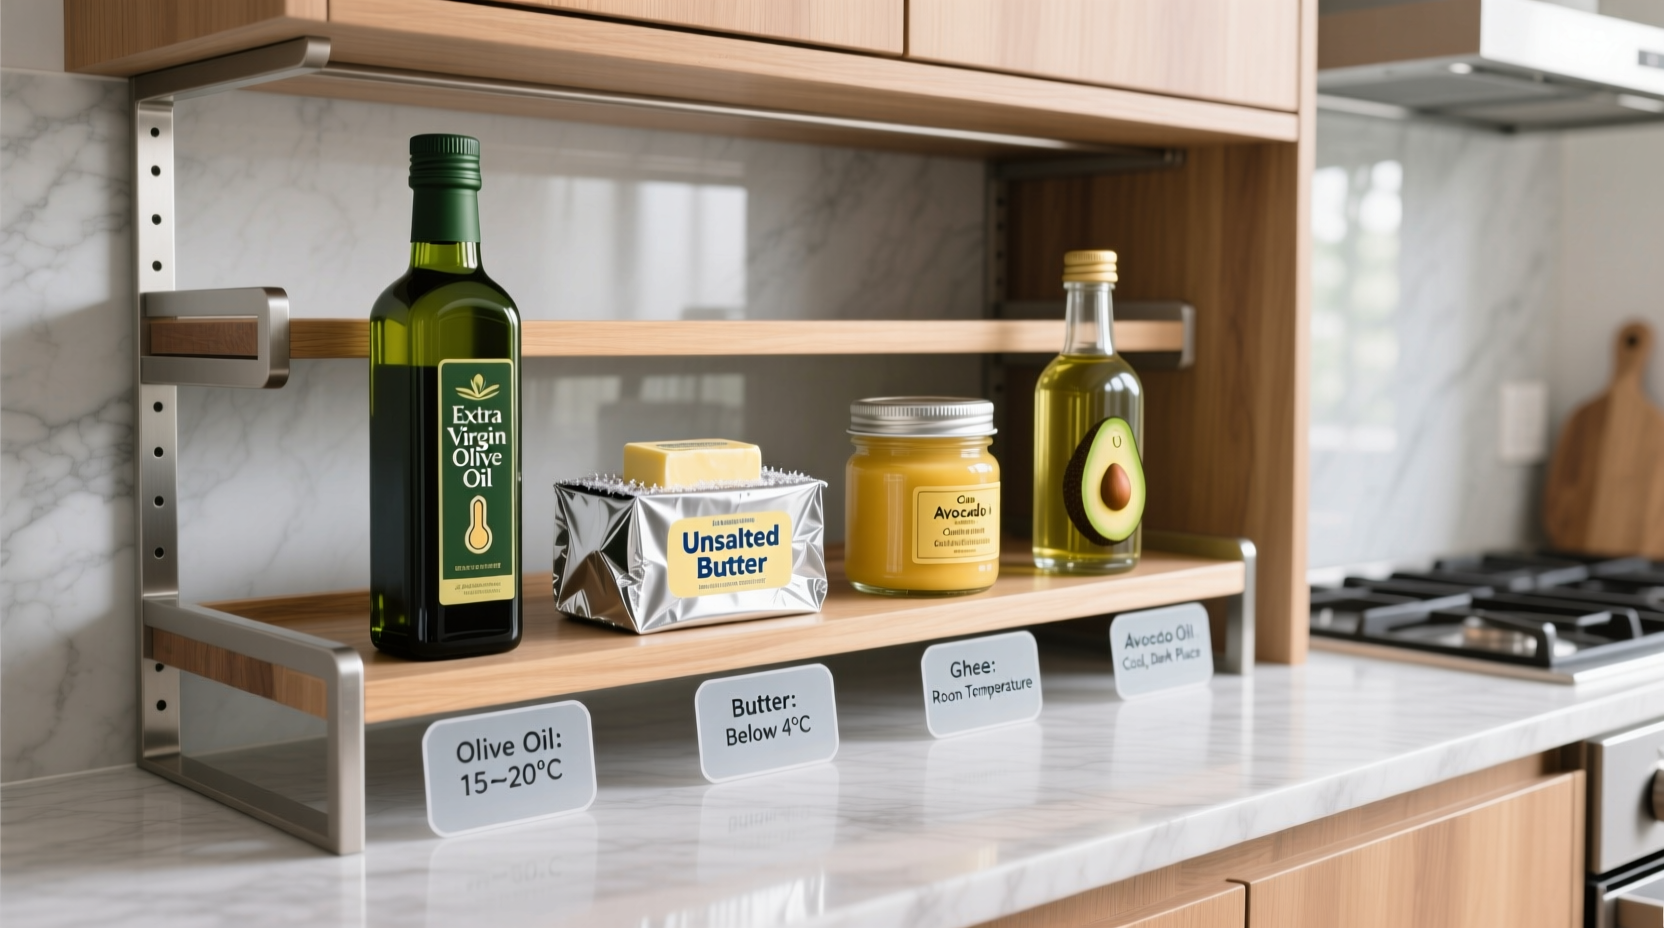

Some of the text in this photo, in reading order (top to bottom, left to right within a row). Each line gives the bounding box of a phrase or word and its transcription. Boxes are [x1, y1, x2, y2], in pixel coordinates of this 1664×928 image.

[452, 405, 502, 424] Extra
[446, 425, 507, 452] Virgin
[452, 447, 502, 467] Olive
[462, 467, 493, 488] Oil
[682, 523, 779, 554] Unsalted
[697, 555, 768, 579] Butter
[950, 659, 996, 679] Ghee:
[732, 694, 796, 718] Butter:
[726, 714, 812, 747] Below 4°C
[456, 726, 562, 764] Olive Oil:
